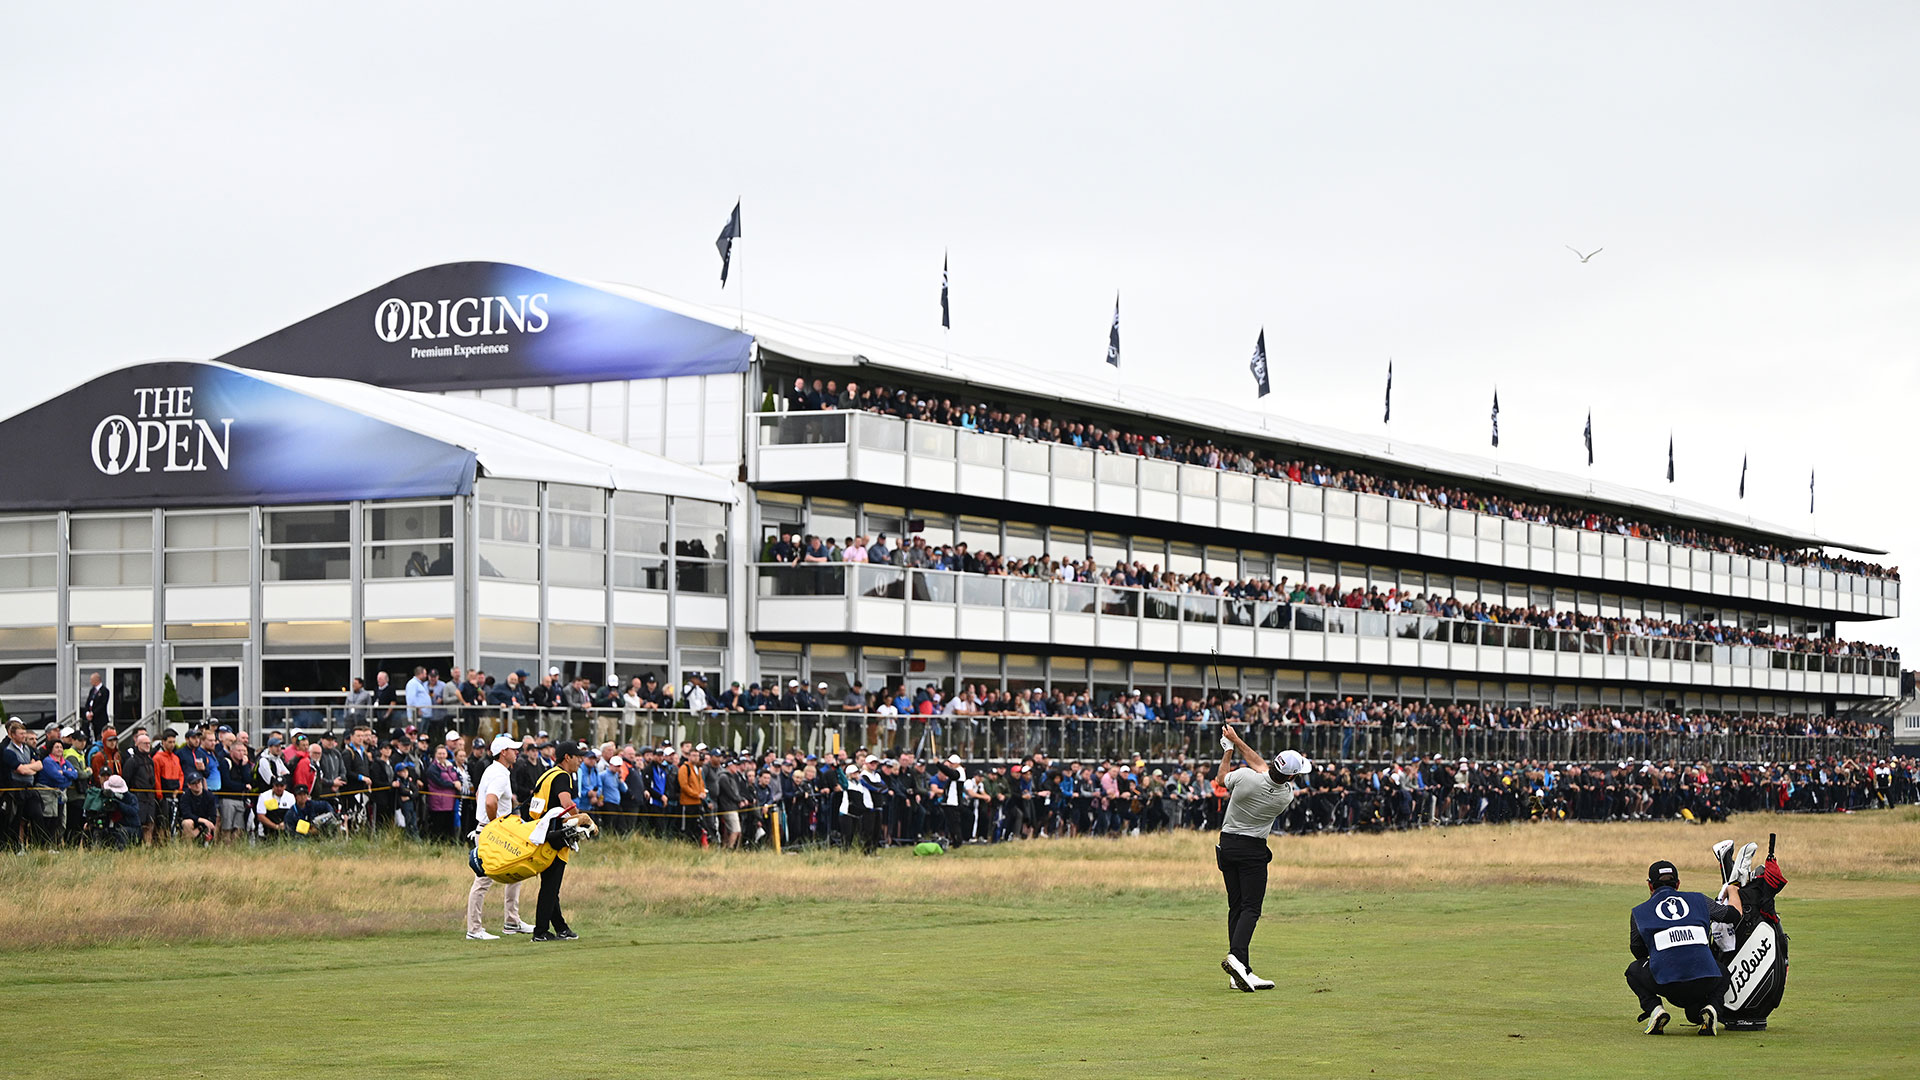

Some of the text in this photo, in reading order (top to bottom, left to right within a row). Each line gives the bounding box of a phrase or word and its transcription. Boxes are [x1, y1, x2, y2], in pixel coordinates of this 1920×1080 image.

[374, 293, 549, 343] ORIGINS
[411, 343, 509, 358] Premium Experiences
[134, 387, 194, 418] THE
[91, 414, 235, 476] OPEN
[486, 831, 522, 857] TaylorMade
[1668, 929, 1695, 943] HOMA
[1727, 937, 1772, 1004] Titleist
